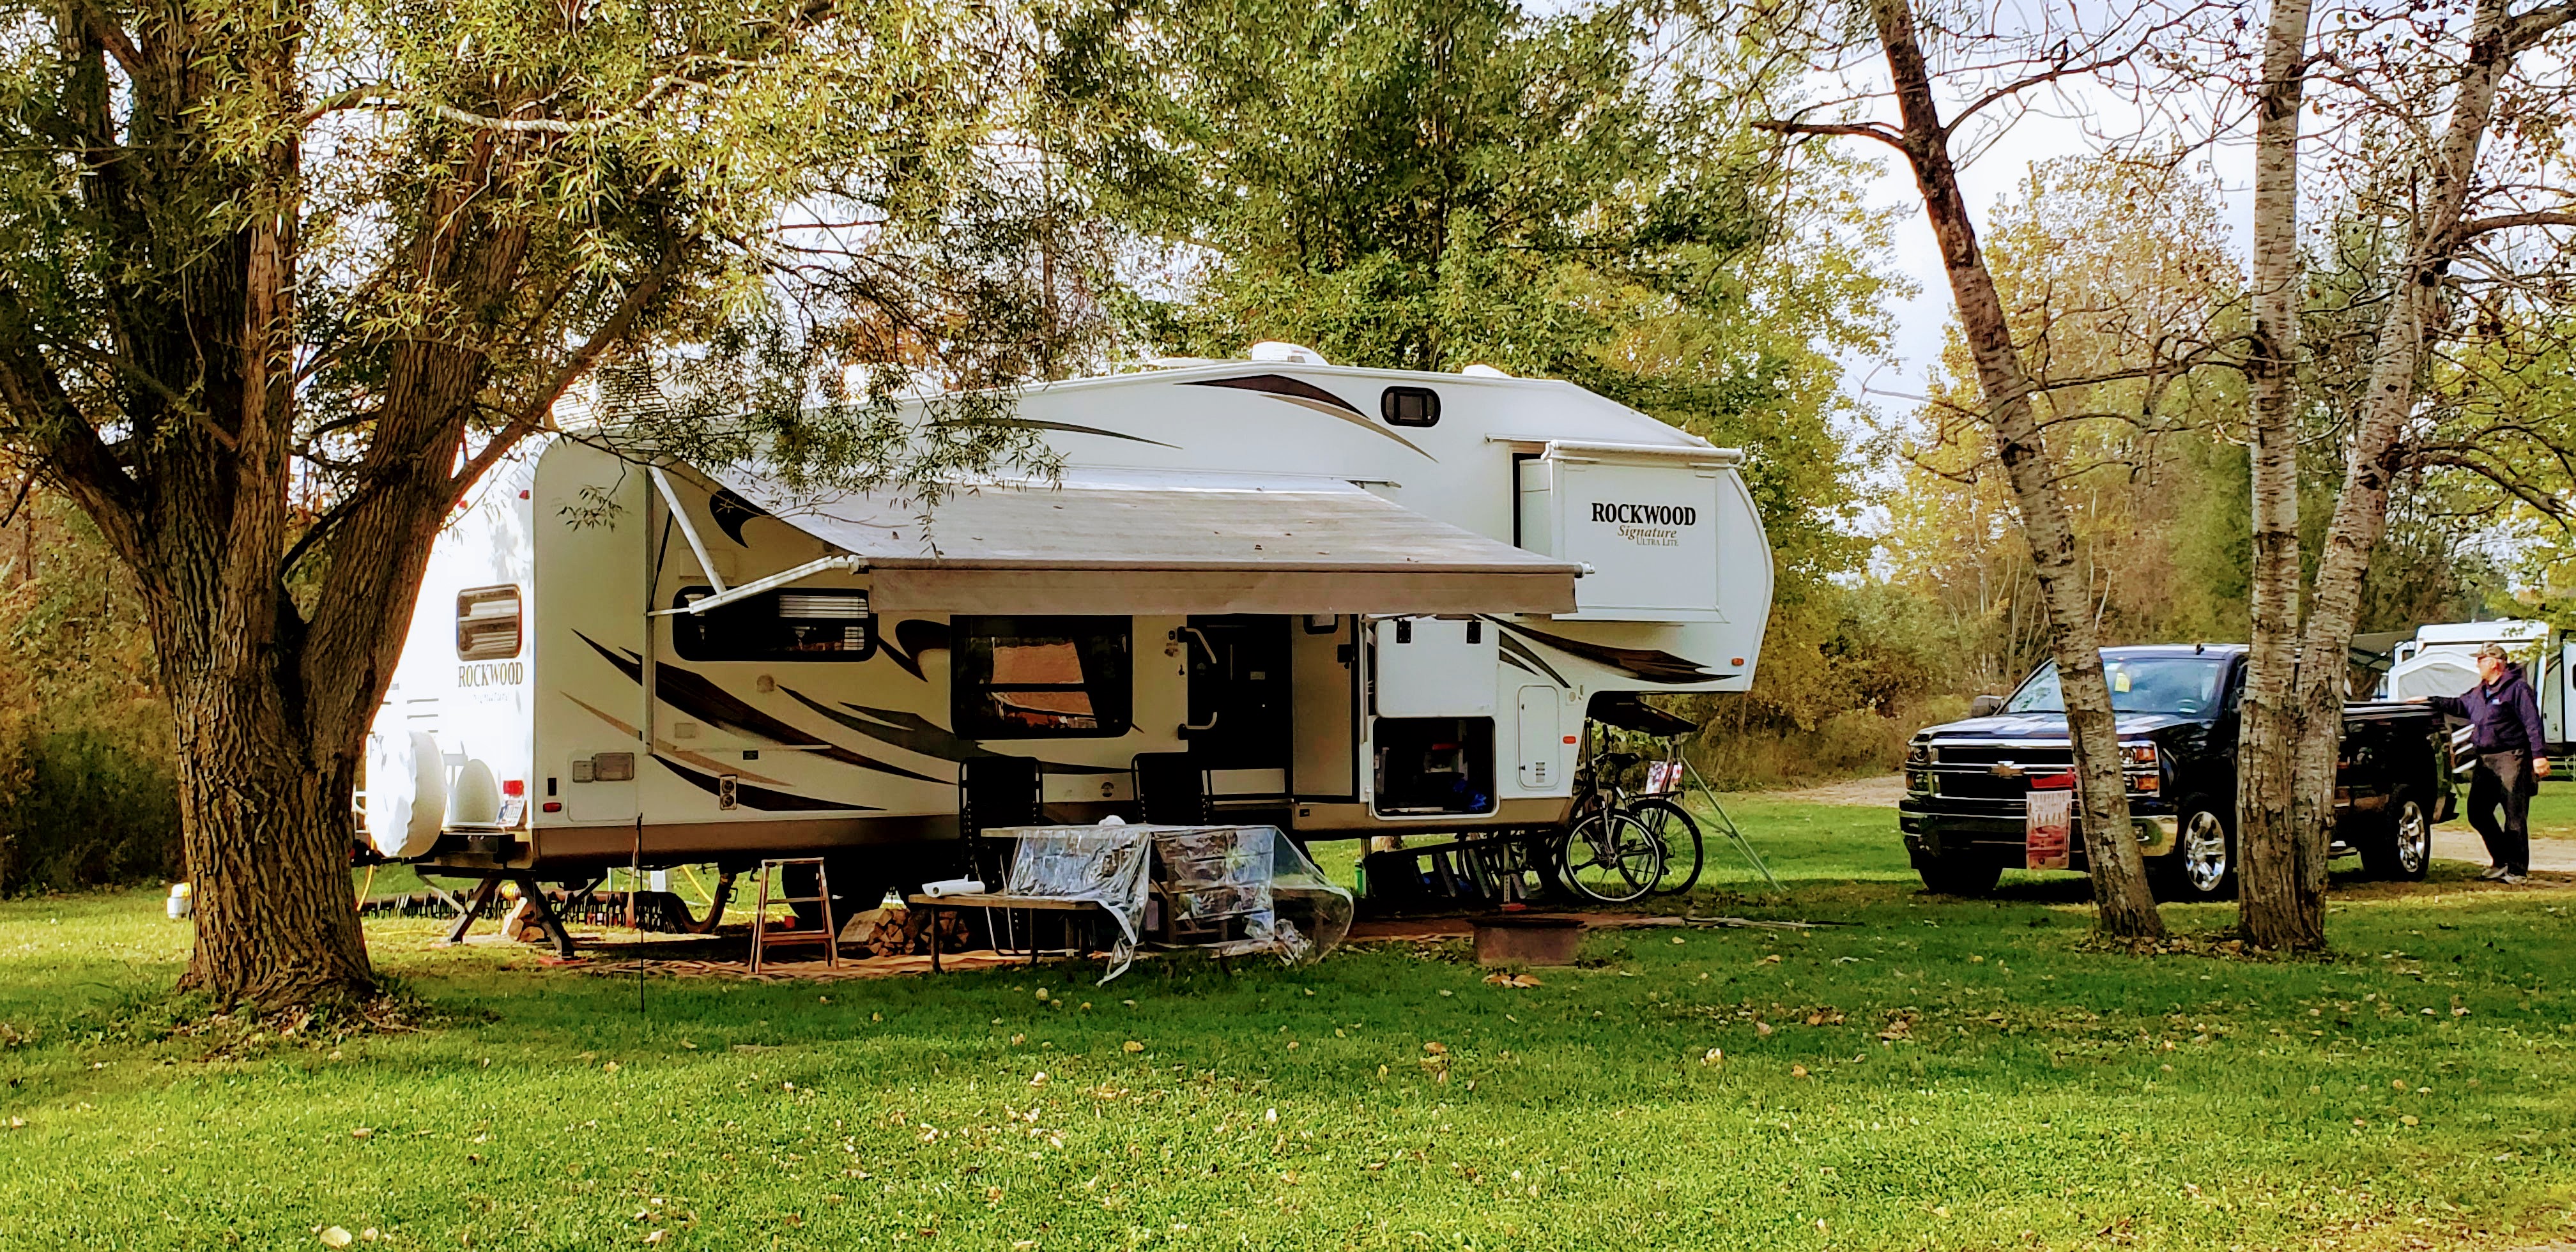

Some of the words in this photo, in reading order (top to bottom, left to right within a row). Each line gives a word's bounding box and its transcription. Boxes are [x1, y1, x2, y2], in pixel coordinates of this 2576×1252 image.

[1591, 503, 1696, 526] ROCKWOOD
[1618, 525, 1677, 540] Signature
[458, 662, 523, 687] ROCKWOOD
